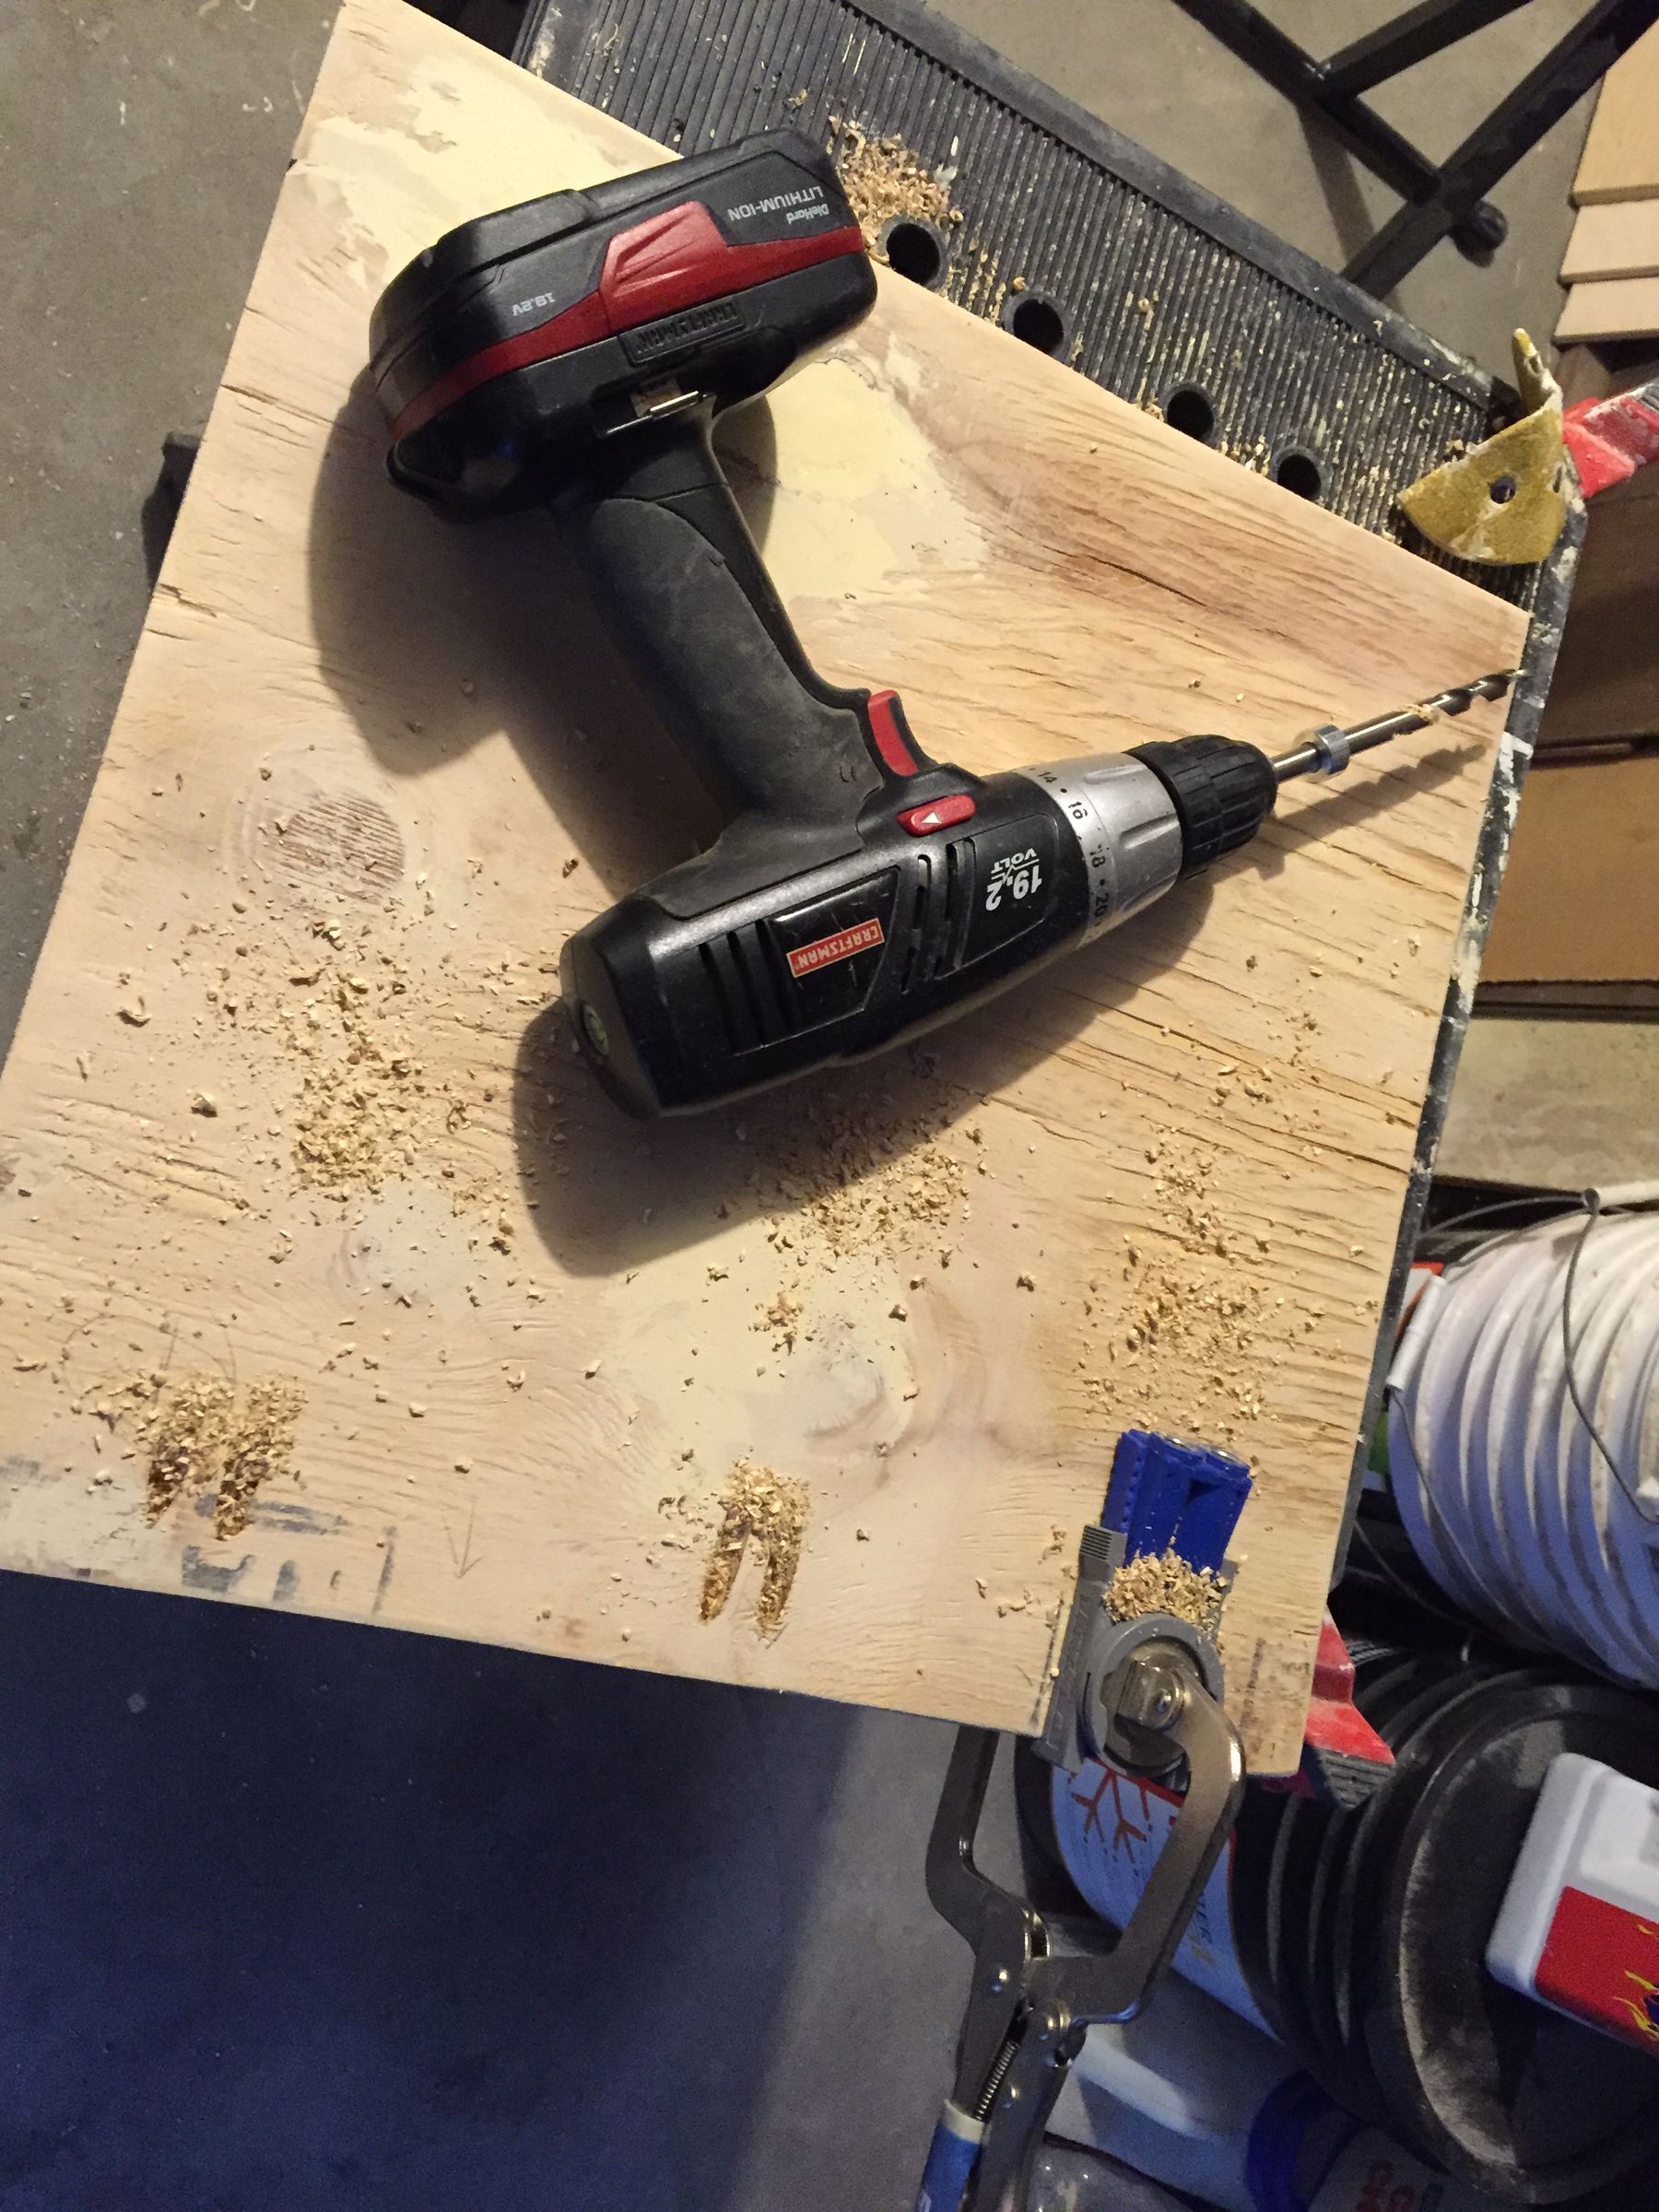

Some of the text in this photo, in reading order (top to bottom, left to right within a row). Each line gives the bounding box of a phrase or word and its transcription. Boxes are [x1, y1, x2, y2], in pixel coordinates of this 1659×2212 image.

[727, 185, 824, 221] LITHIUM-ION
[786, 203, 830, 225] DieHard
[1068, 801, 1088, 819] 16
[991, 848, 1037, 874] VOLT
[985, 865, 1042, 911] 19.2
[796, 925, 879, 970] CRAFTSMAN
